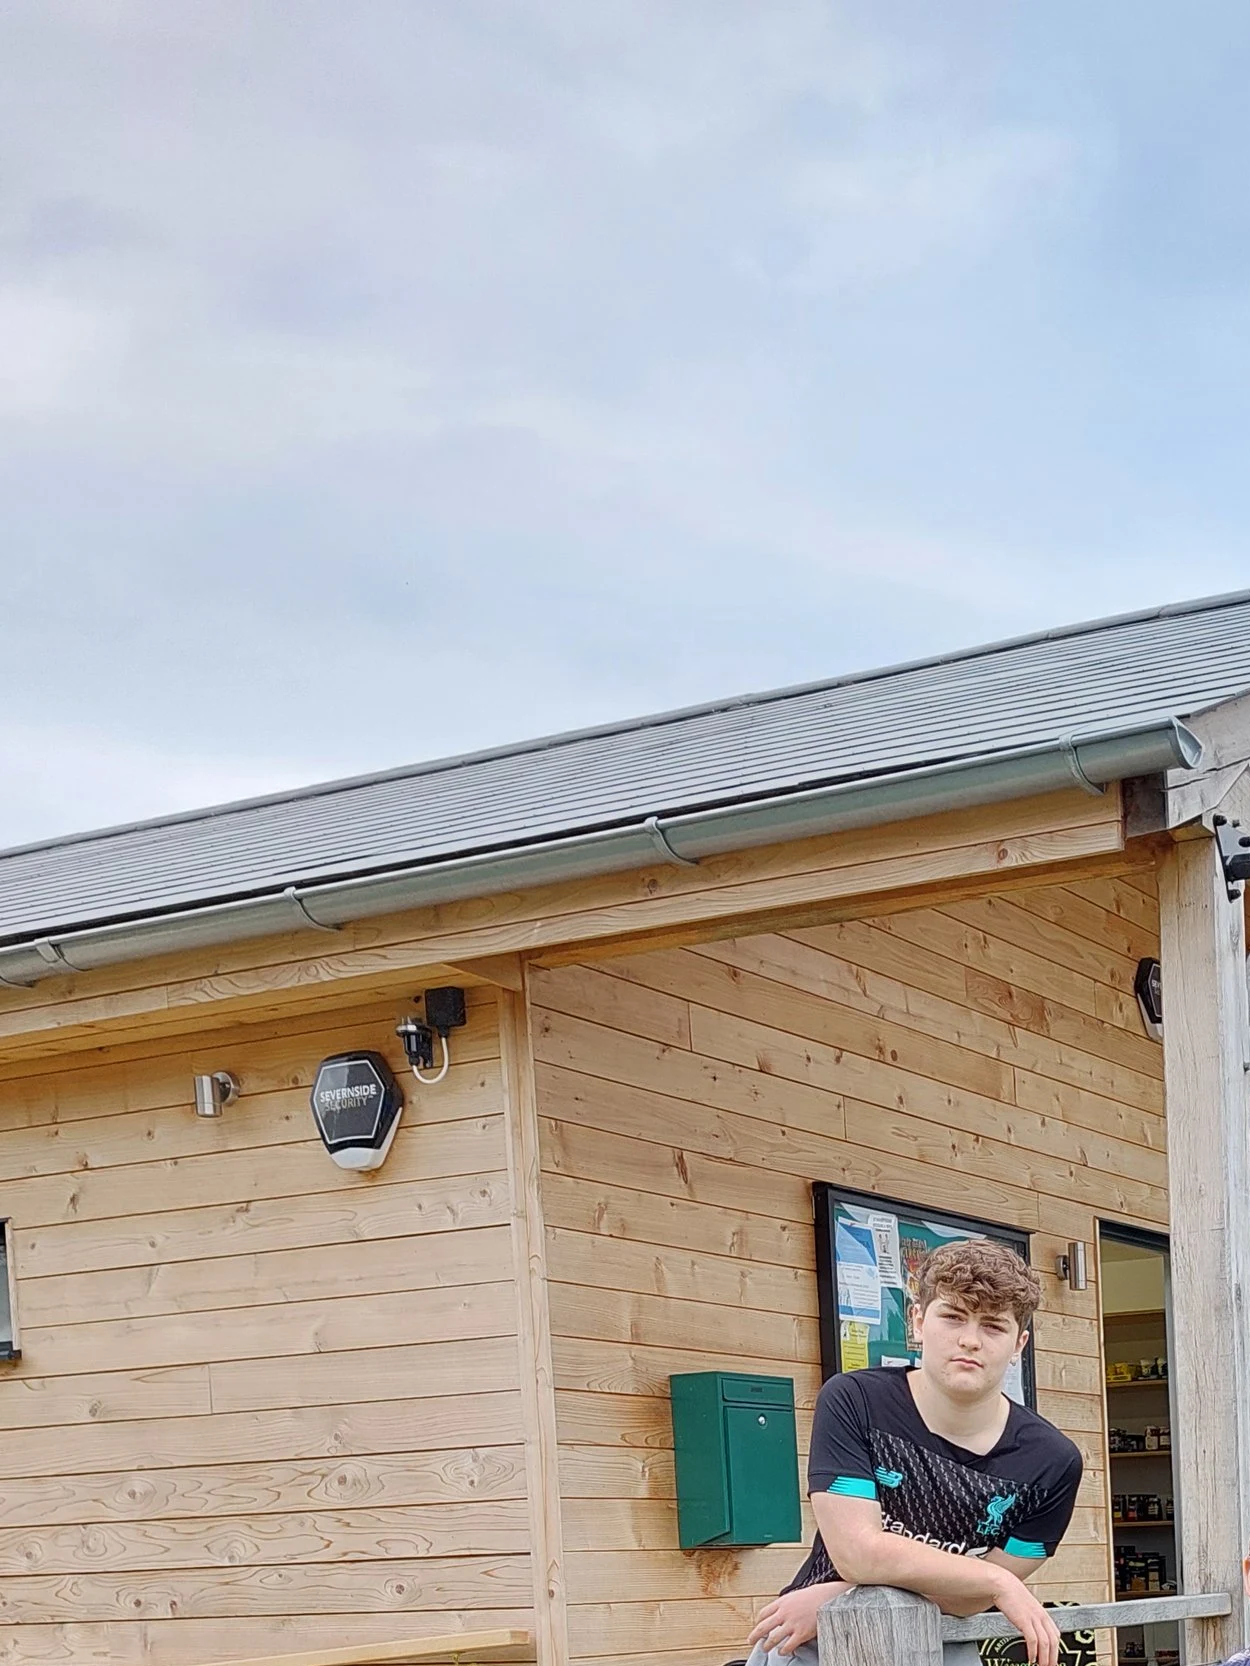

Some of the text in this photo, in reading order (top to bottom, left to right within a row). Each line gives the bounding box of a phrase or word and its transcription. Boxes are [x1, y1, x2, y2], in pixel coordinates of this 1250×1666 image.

[320, 1083, 377, 1103] SEVERNSIDE
[325, 1095, 368, 1112] SECURITY
[976, 1520, 1001, 1536] LFC
